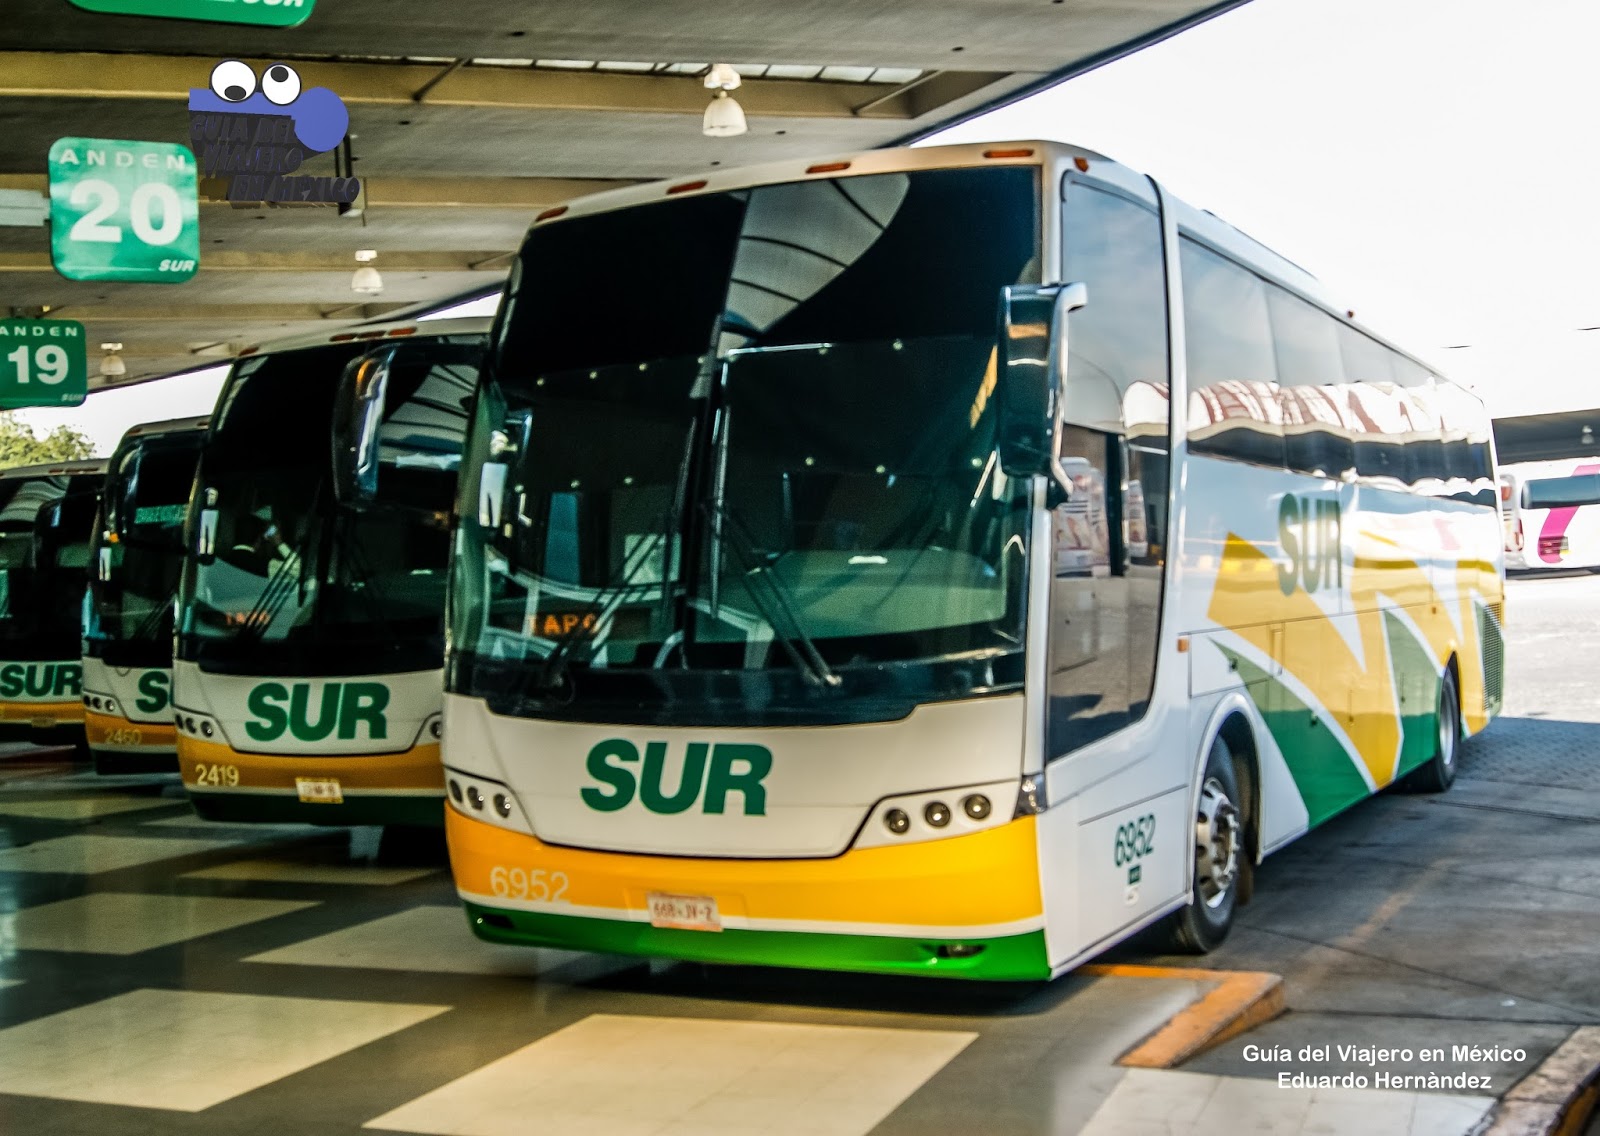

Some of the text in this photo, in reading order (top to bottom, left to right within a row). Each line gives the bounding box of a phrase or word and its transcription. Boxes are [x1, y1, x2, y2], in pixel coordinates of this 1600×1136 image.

[59, 149, 186, 169] ANDEN
[69, 179, 183, 246] 20
[158, 259, 196, 272] SUR
[0, 326, 78, 337] ANDEN
[7, 344, 69, 385] 19
[1277, 493, 1342, 596] SUR
[0, 664, 82, 697] SUR
[245, 682, 391, 742] SUR
[195, 764, 240, 787] 2419
[580, 738, 773, 816] SUR
[1114, 813, 1156, 867] 6952
[489, 865, 569, 903] 6952
